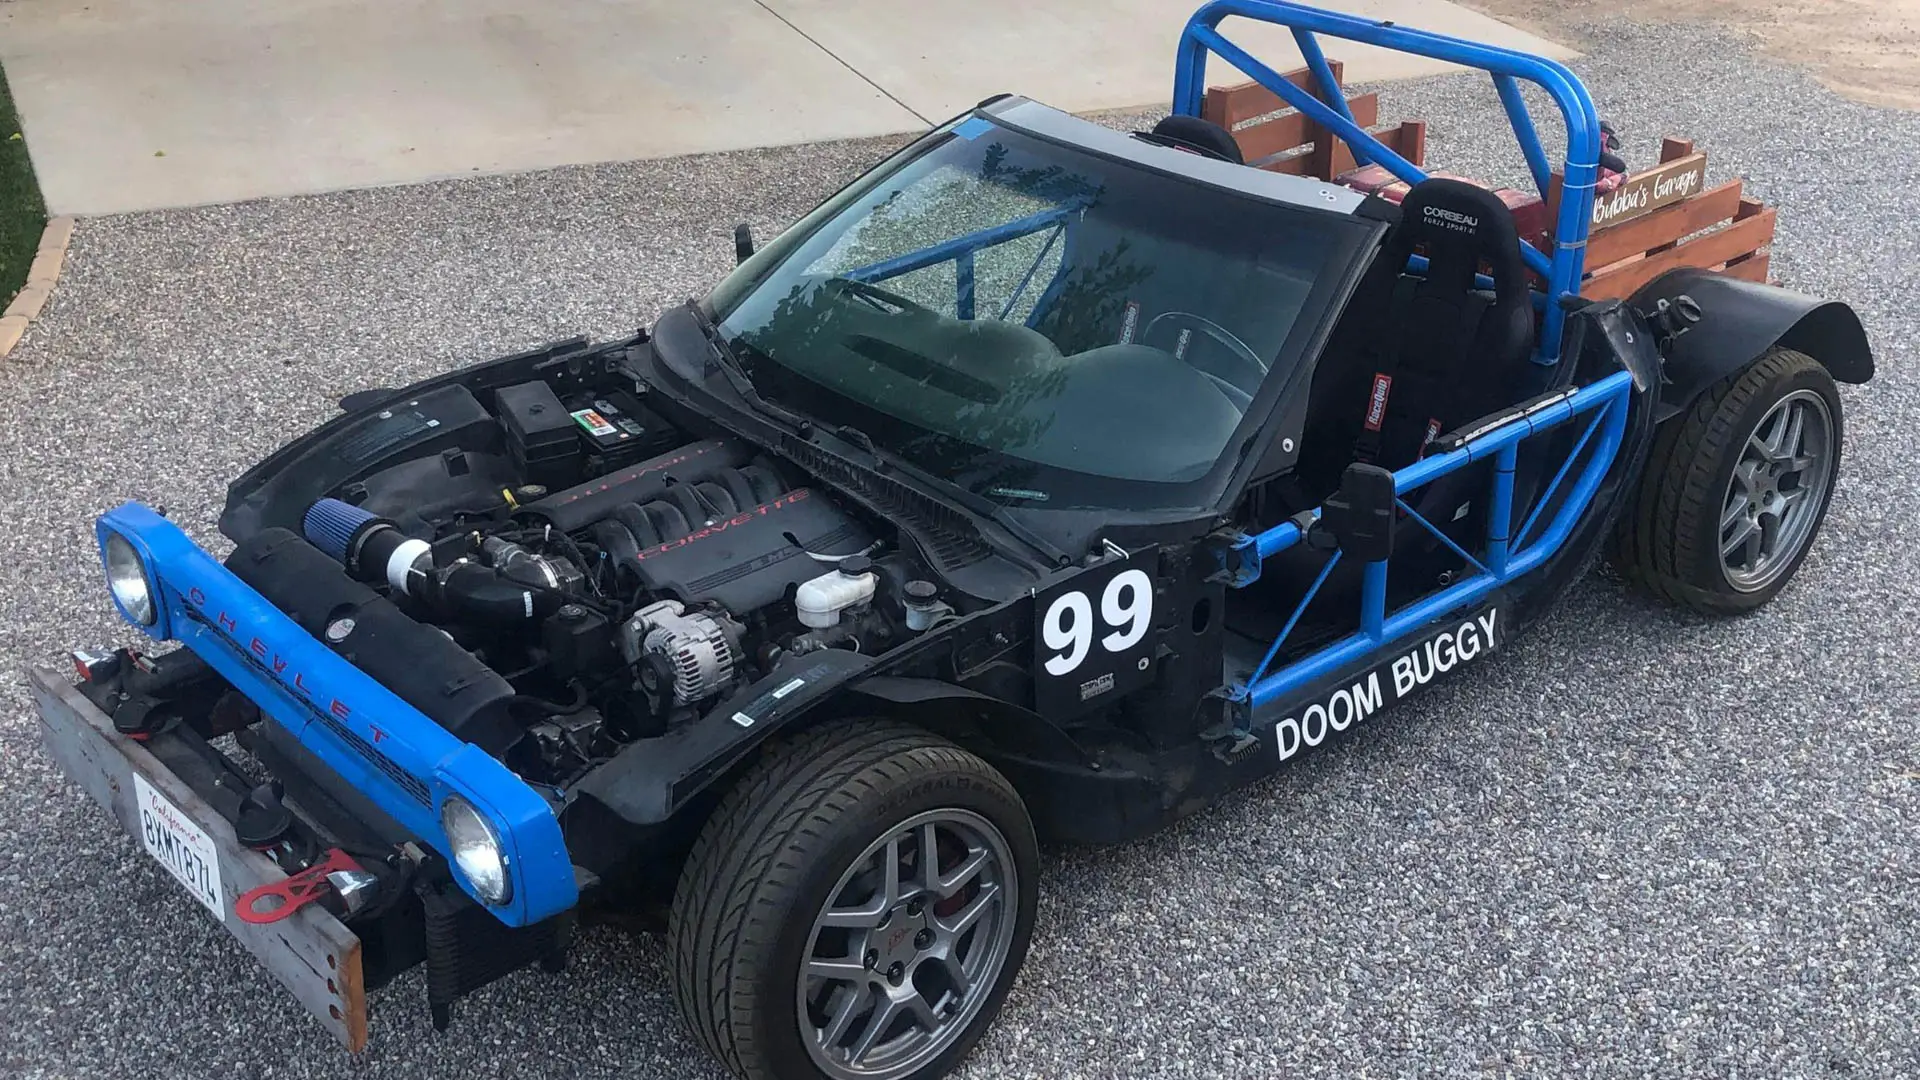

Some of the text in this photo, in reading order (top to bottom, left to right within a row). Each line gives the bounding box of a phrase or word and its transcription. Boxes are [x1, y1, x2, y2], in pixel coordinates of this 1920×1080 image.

[1423, 206, 1478, 226] CORBEAU
[1592, 168, 1699, 224] Bubba's Garage
[1368, 378, 1387, 425] RaceQuip
[637, 488, 810, 561] CORVETTE
[1042, 568, 1153, 677] 99
[1275, 608, 1497, 762] DOOM BUGGY
[143, 809, 217, 905] 8XMT874
